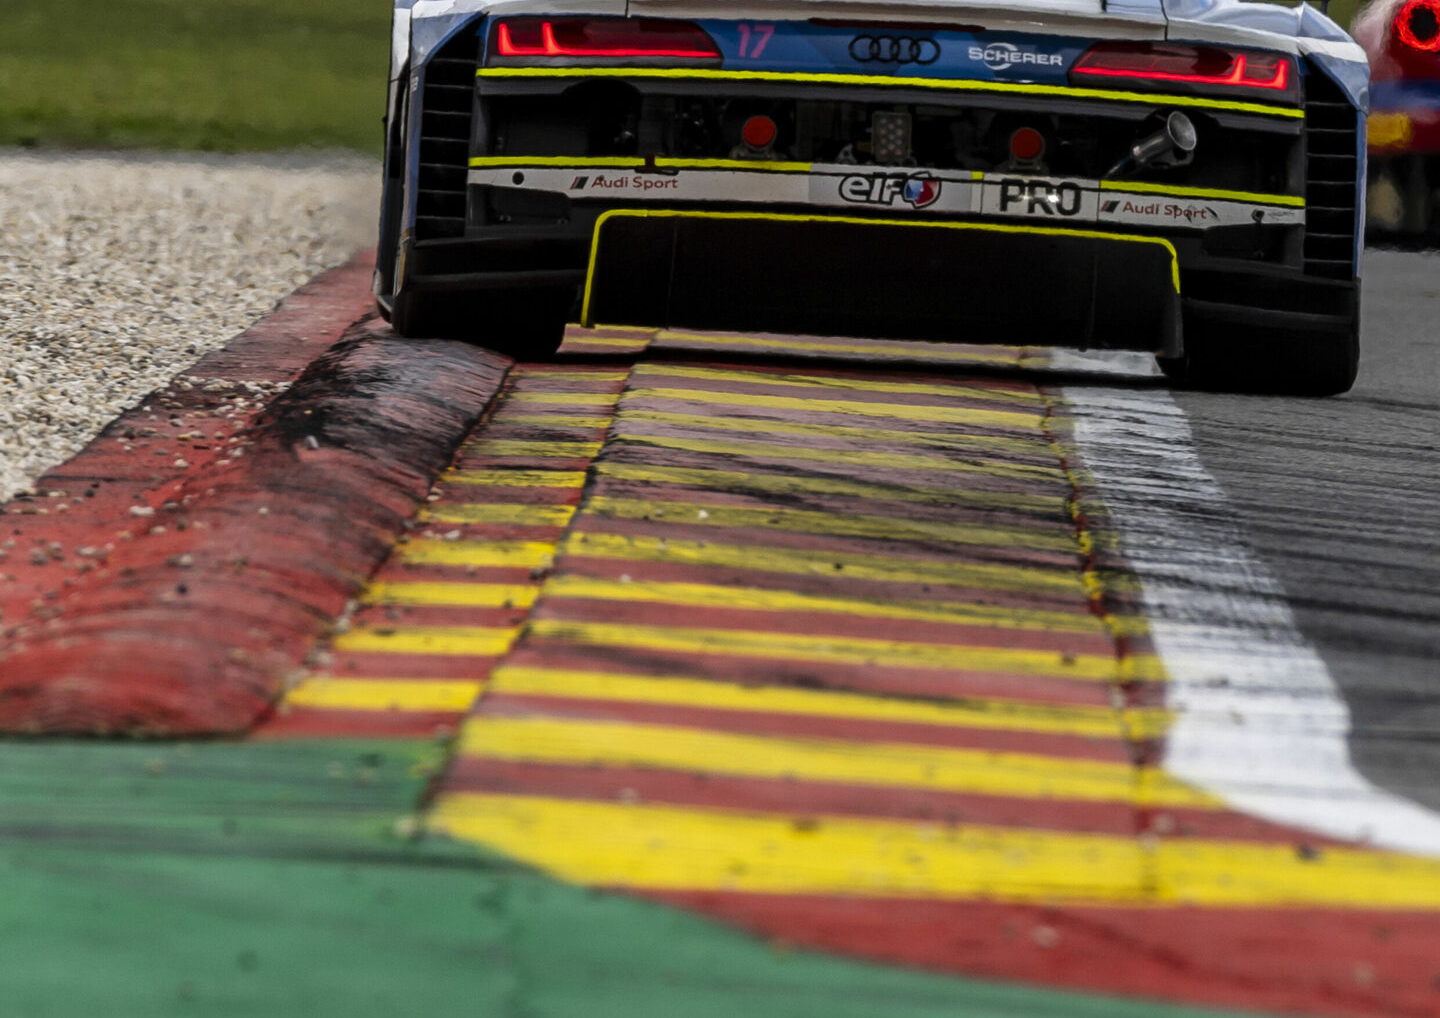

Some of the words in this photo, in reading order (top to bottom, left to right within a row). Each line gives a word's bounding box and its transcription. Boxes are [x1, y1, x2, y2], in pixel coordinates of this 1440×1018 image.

[737, 24, 775, 59] 17
[968, 43, 1062, 68] SCHERER
[591, 175, 629, 189] Audi
[633, 176, 678, 190] Sport
[839, 171, 910, 205] elf
[1000, 178, 1082, 216] PRO
[1122, 201, 1159, 215] Audi
[1164, 204, 1207, 220] Sport
